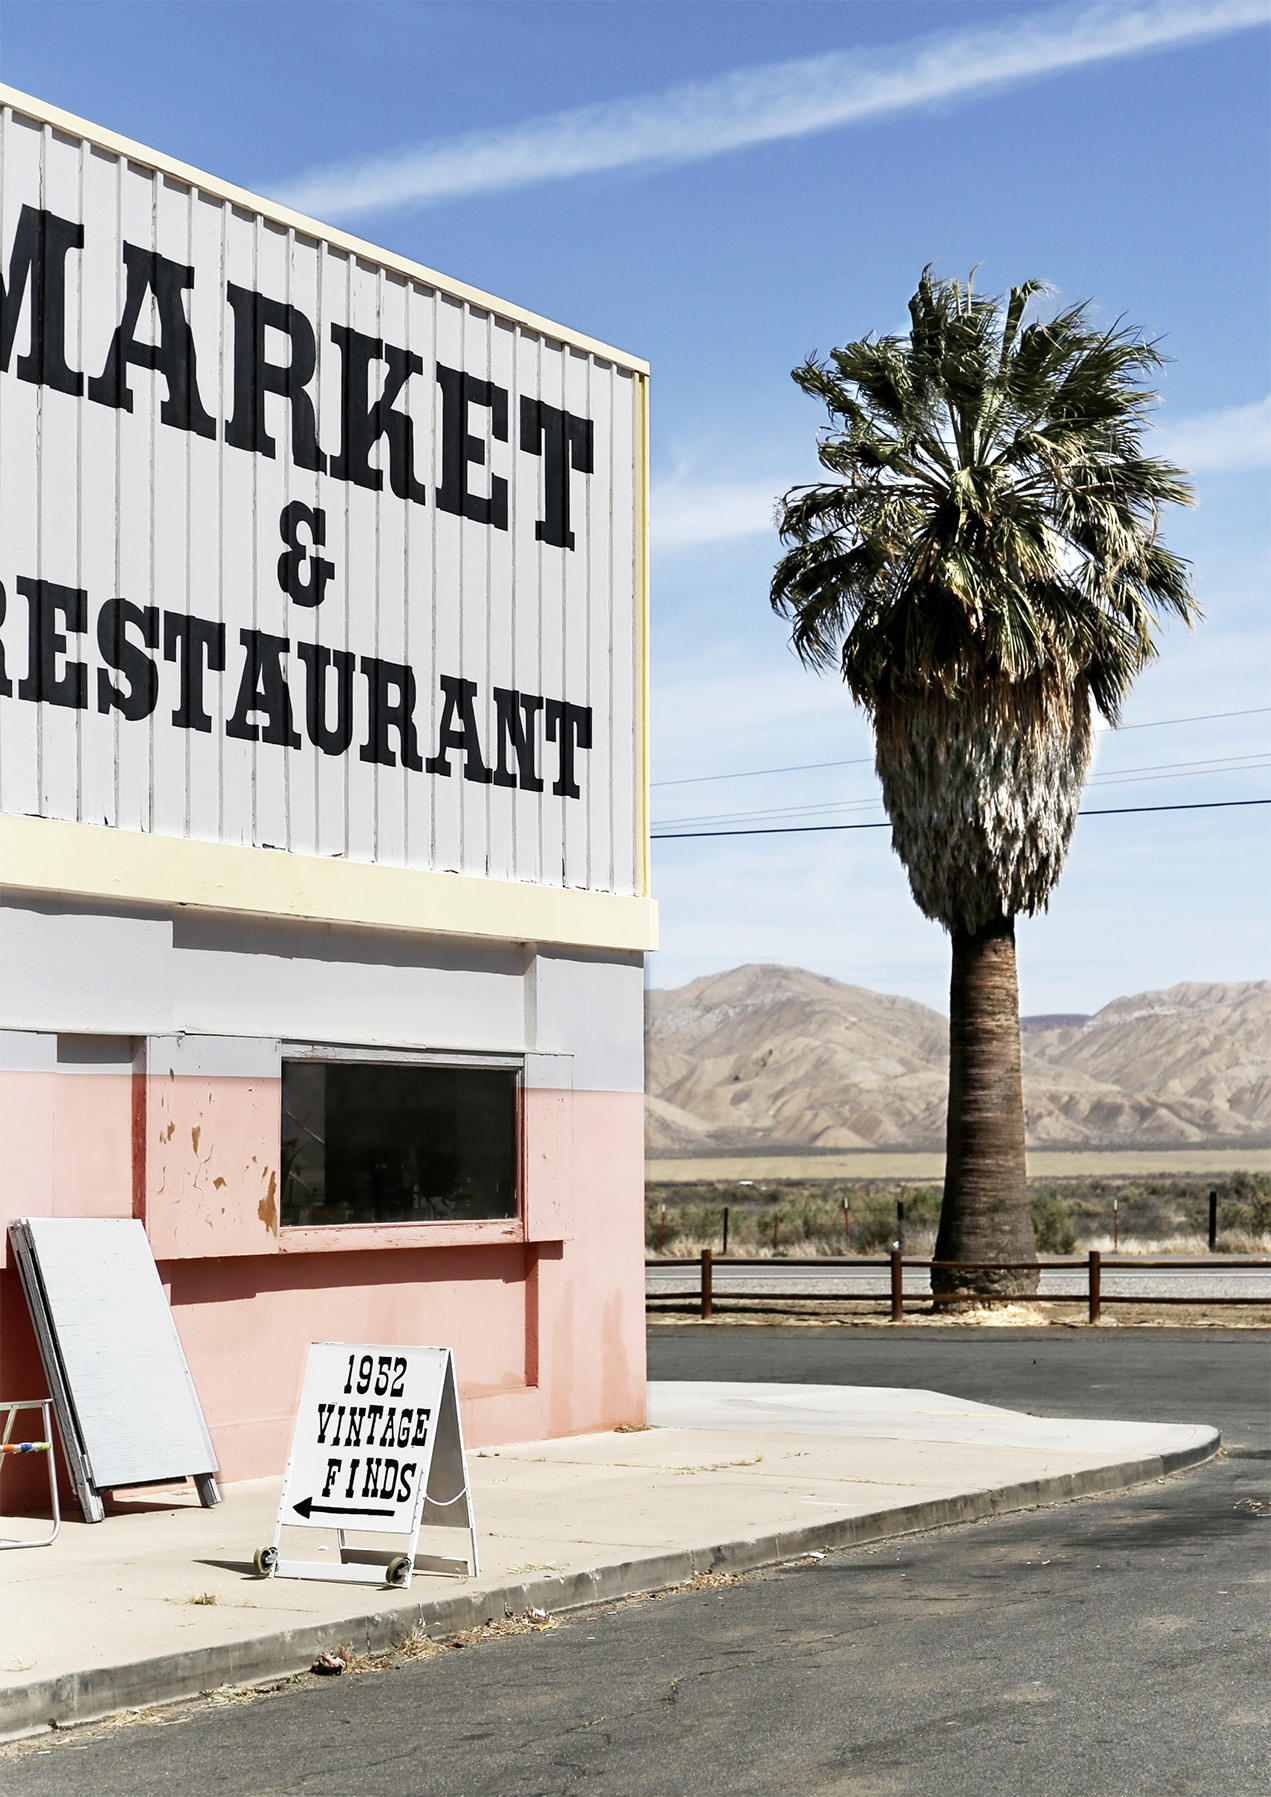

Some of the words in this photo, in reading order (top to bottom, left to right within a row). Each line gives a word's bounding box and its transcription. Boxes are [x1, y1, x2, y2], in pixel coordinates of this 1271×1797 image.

[278, 500, 335, 608] &
[0, 575, 593, 800] ESTAURANT
[343, 1354, 408, 1398] 1952
[317, 1403, 431, 1449] VINTAGE
[321, 1457, 417, 1503] FINDS
